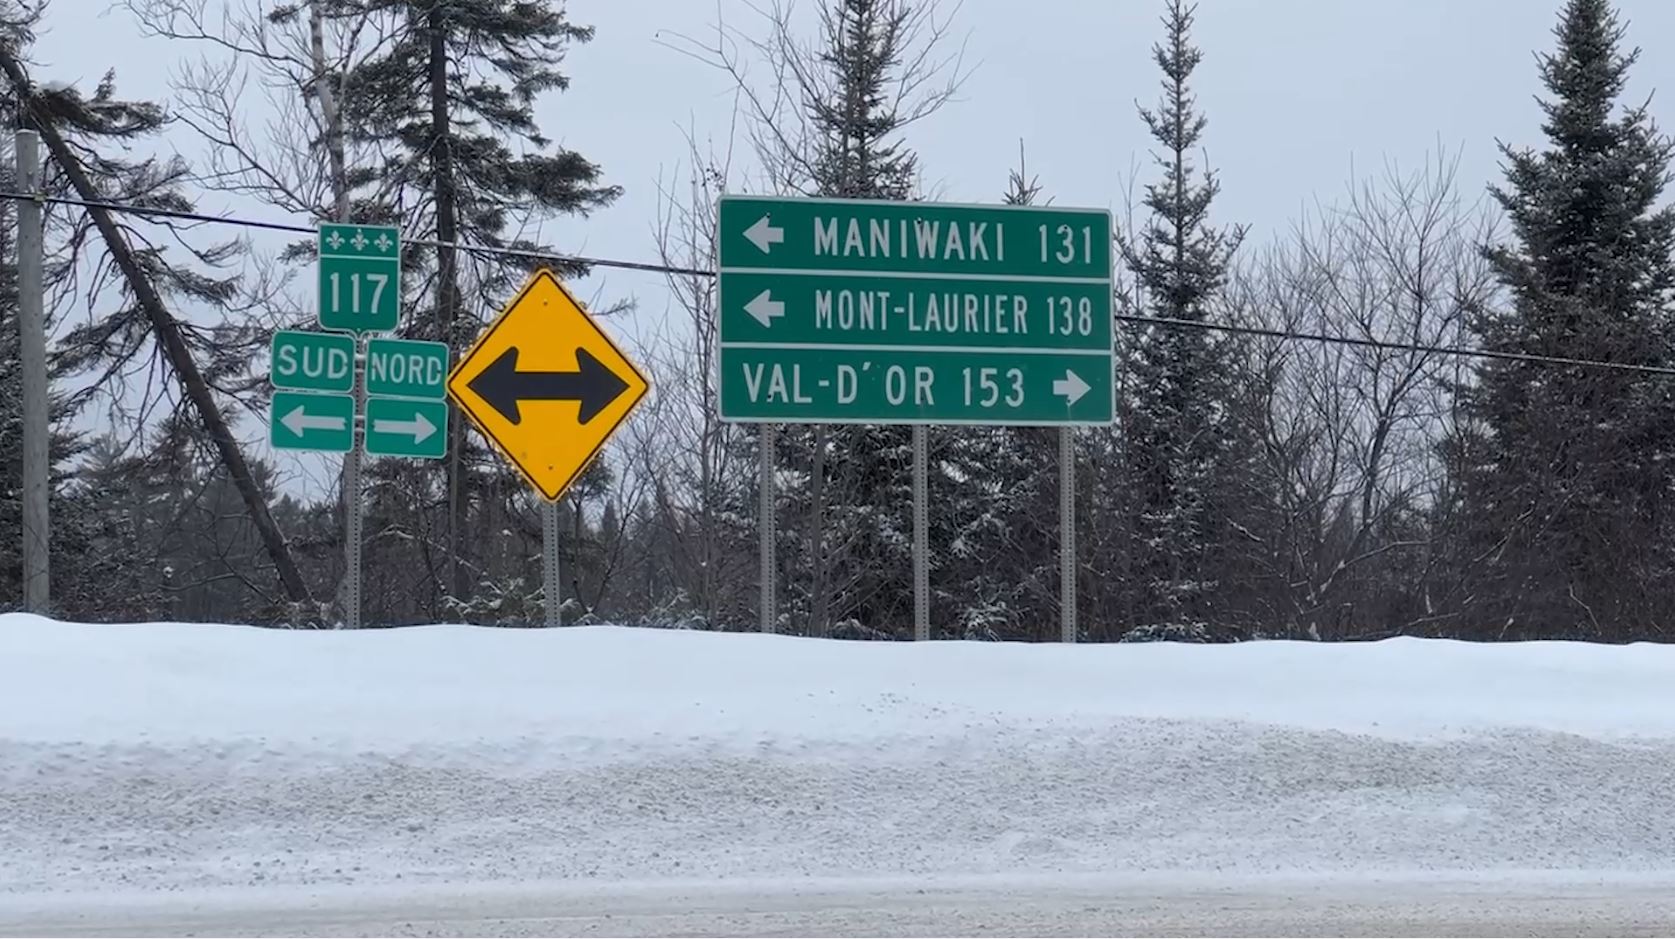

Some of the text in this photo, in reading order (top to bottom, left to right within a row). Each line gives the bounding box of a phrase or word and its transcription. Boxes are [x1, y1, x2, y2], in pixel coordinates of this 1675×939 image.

[814, 216, 1092, 264] MANIWAKI 131
[330, 272, 389, 314] 117
[814, 289, 1094, 337] MONT-LAURIER 138
[278, 344, 349, 379] SUD
[370, 353, 442, 386] NORD
[962, 367, 1026, 408] 153
